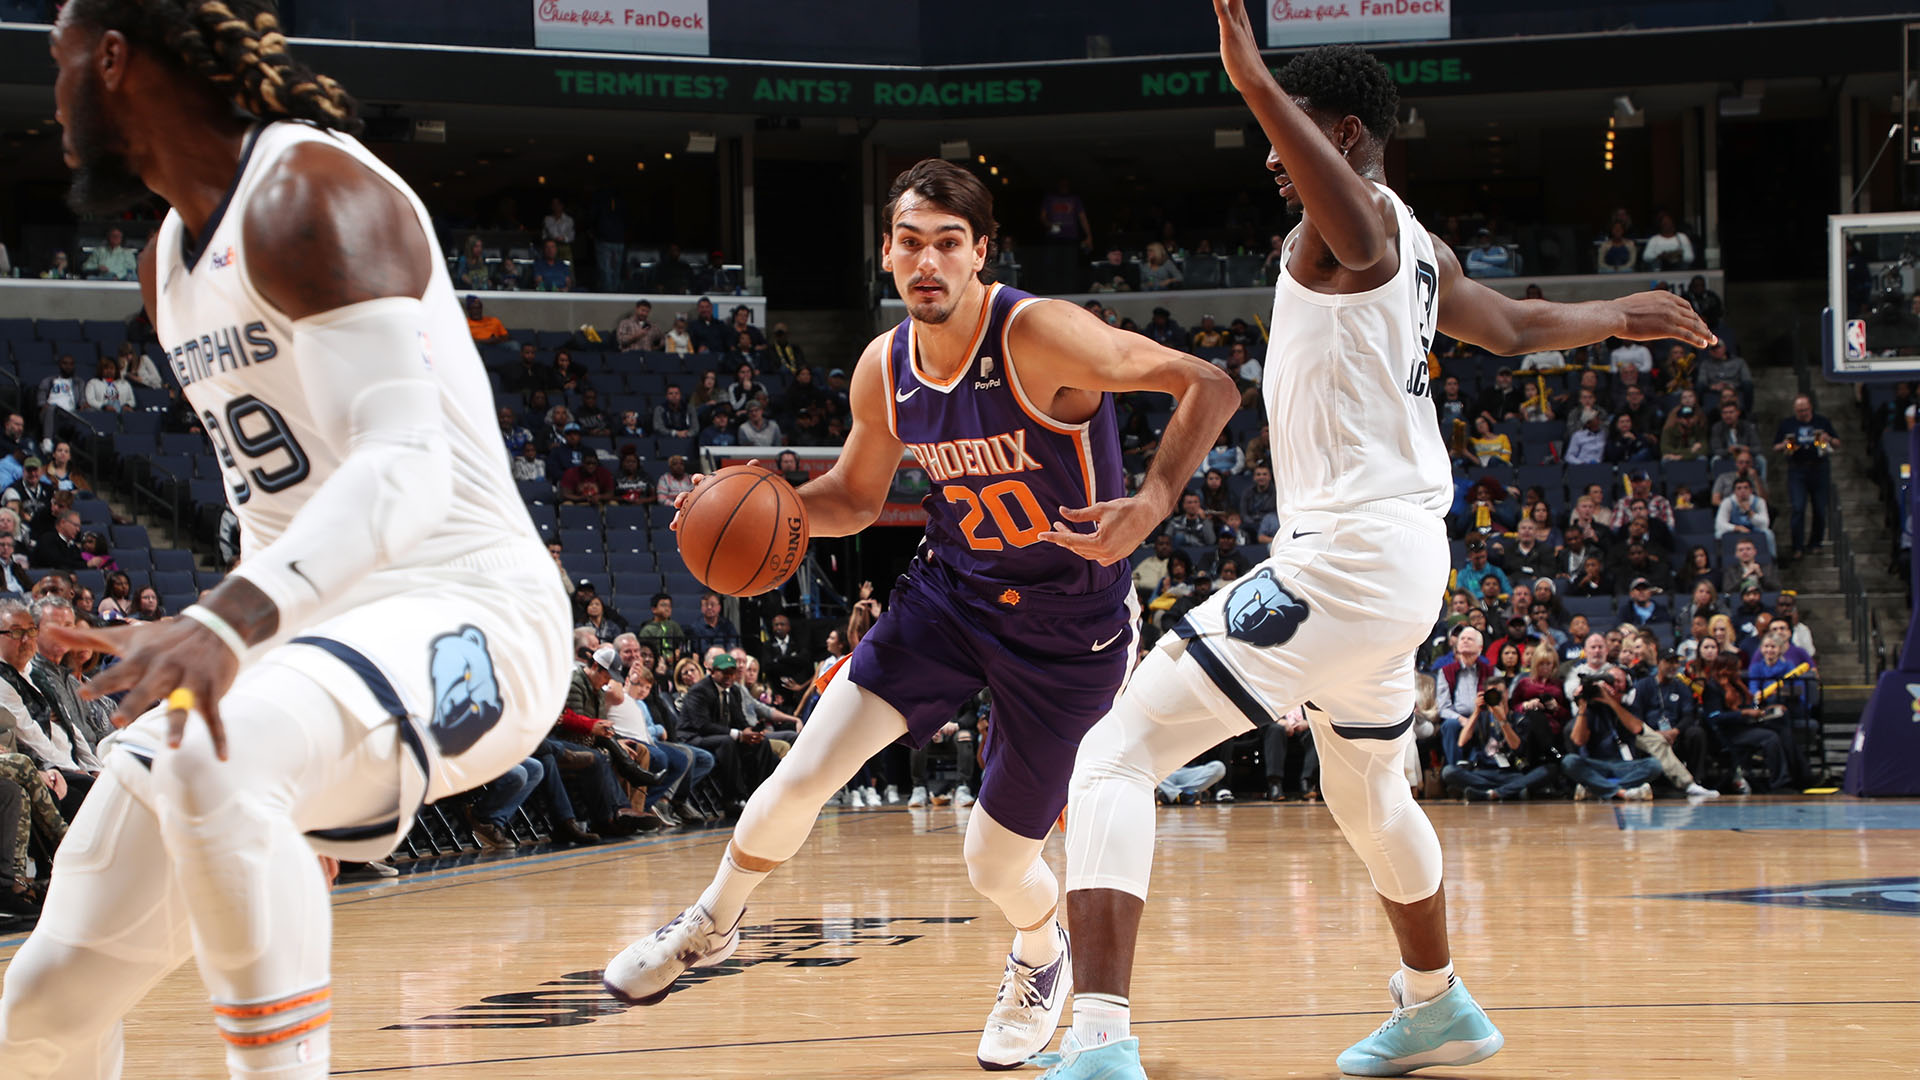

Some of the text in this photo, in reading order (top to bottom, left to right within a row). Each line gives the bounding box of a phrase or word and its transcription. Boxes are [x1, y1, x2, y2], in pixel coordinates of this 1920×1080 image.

[624, 9, 703, 29] FanDeck
[1360, 0, 1445, 16] FanDeck
[555, 69, 1043, 105] TERMITES? ANTS? ROACHES?
[1142, 71, 1211, 96] NOT
[974, 378, 1001, 391] PayPal
[905, 428, 1043, 482] PHOENIX
[943, 479, 1052, 552] 20
